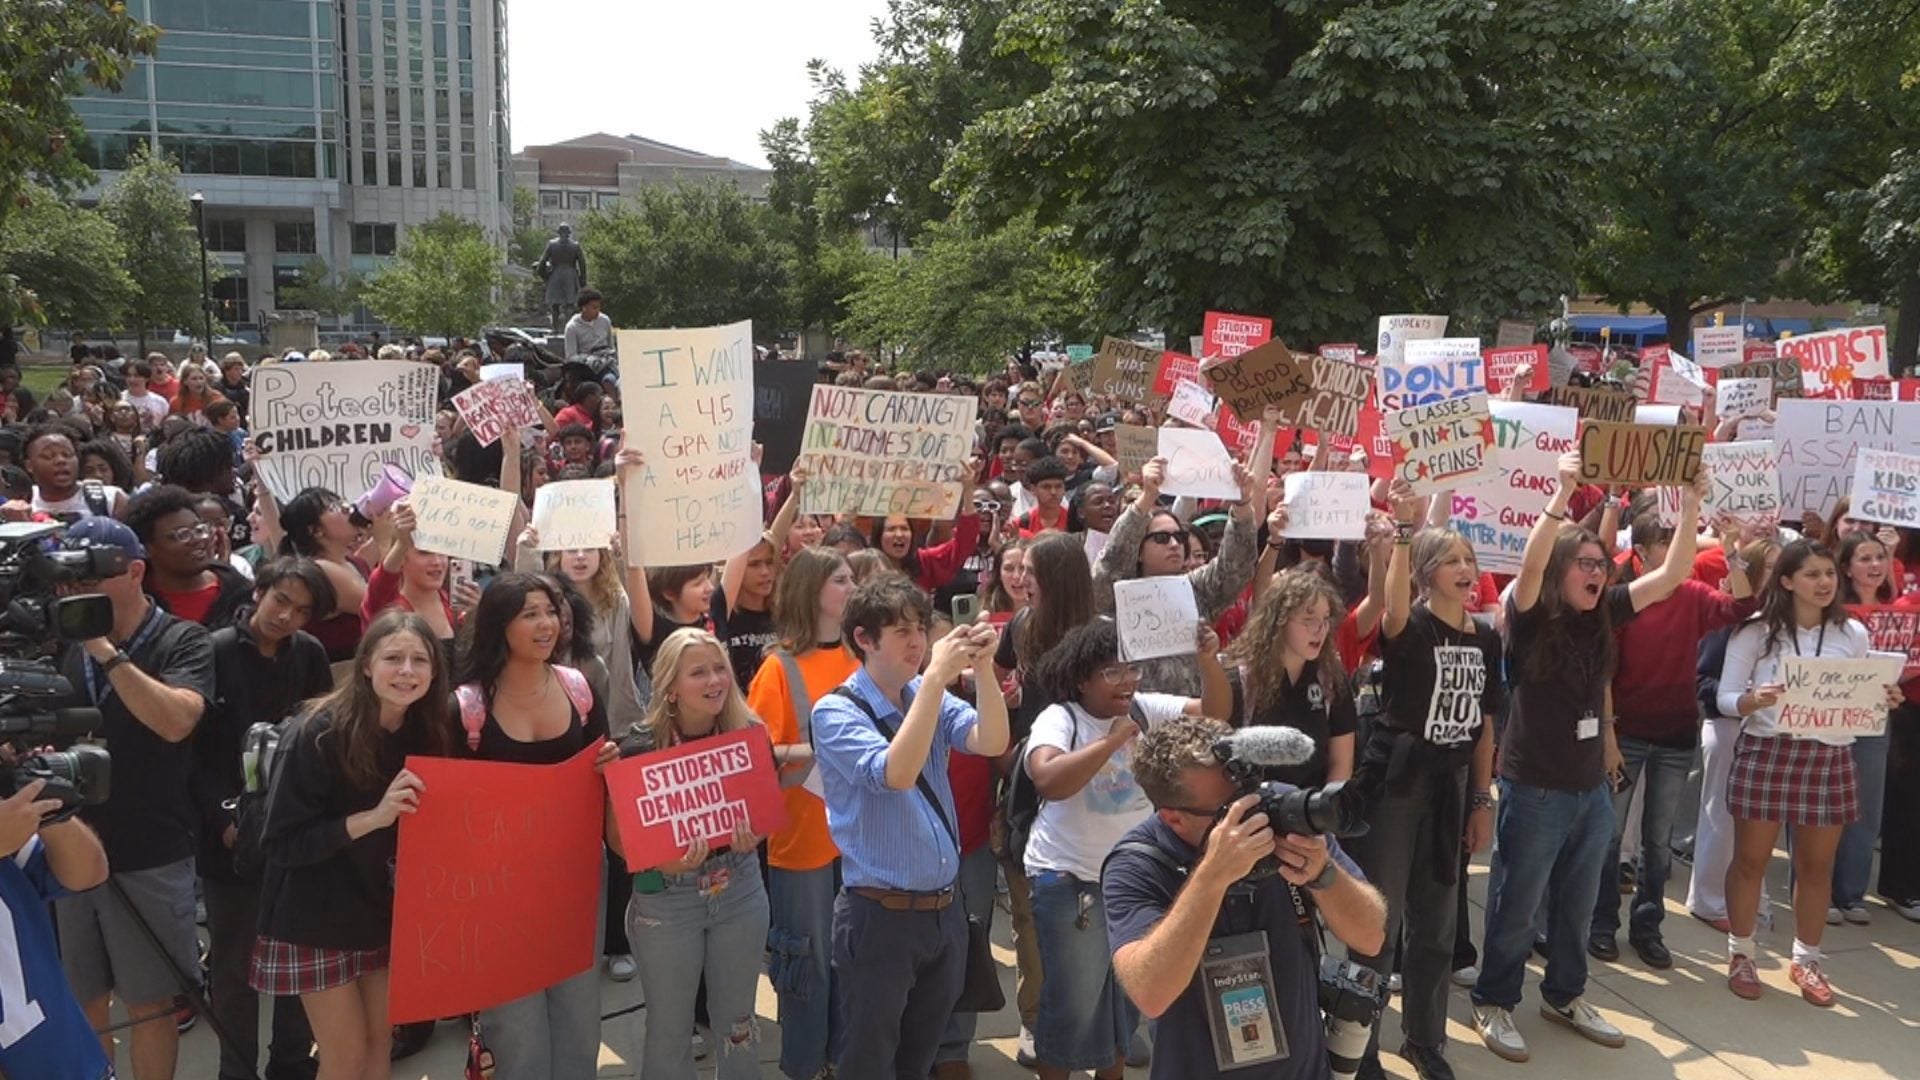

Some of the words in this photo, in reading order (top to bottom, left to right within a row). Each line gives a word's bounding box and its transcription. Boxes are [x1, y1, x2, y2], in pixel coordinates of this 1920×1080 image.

[1213, 331, 1245, 345] DEMAND
[1219, 321, 1262, 334] STUDENTS
[1390, 318, 1431, 330] STUDENTS
[642, 346, 683, 389] I
[690, 337, 744, 387] WANT
[1107, 341, 1160, 363] PROTEC
[1115, 358, 1146, 372] KIDS
[1493, 352, 1537, 364] STUDENTS
[1122, 370, 1150, 384] NOT
[1230, 362, 1291, 394] BLOOD
[1311, 356, 1372, 402] SCHOOLS
[1489, 366, 1517, 376] DEMAN
[254, 367, 397, 430] Protect
[1104, 380, 1146, 401] GUNS
[658, 402, 678, 428] A
[697, 393, 734, 427] 4.5
[813, 386, 865, 421] NOT
[865, 392, 954, 427] CARING
[1296, 391, 1363, 438] AGAIN
[1399, 397, 1471, 427] CLASSES
[1825, 403, 1894, 435] BAN
[254, 422, 392, 455] CHILDREN
[662, 434, 711, 460] GPA
[717, 427, 745, 454] NOT
[1535, 431, 1573, 453] GUNS
[1403, 443, 1483, 481] CFFINS!
[262, 452, 351, 504] NOT
[643, 470, 657, 488] A
[1510, 468, 1557, 496] GUNS
[1735, 473, 1769, 487] OUR
[1873, 470, 1918, 492] KIDS
[663, 496, 701, 524] TO
[708, 484, 743, 511] THE
[1728, 493, 1777, 511] LIVES
[1861, 500, 1917, 521] GUNS
[676, 521, 737, 552] HEAD
[1500, 531, 1530, 552] MOR
[1439, 651, 1483, 667] CONTRO
[1440, 667, 1487, 692] GUNS
[1785, 662, 1809, 689] We
[1819, 670, 1842, 685] are
[1848, 672, 1878, 692] your
[1433, 691, 1482, 724] NOT
[1778, 704, 1841, 729] ASSAULT
[645, 745, 749, 790] STUDENTS
[640, 781, 722, 823] DEMAND
[676, 802, 746, 843] ACTION
[1224, 996, 1265, 1016] PRESS
